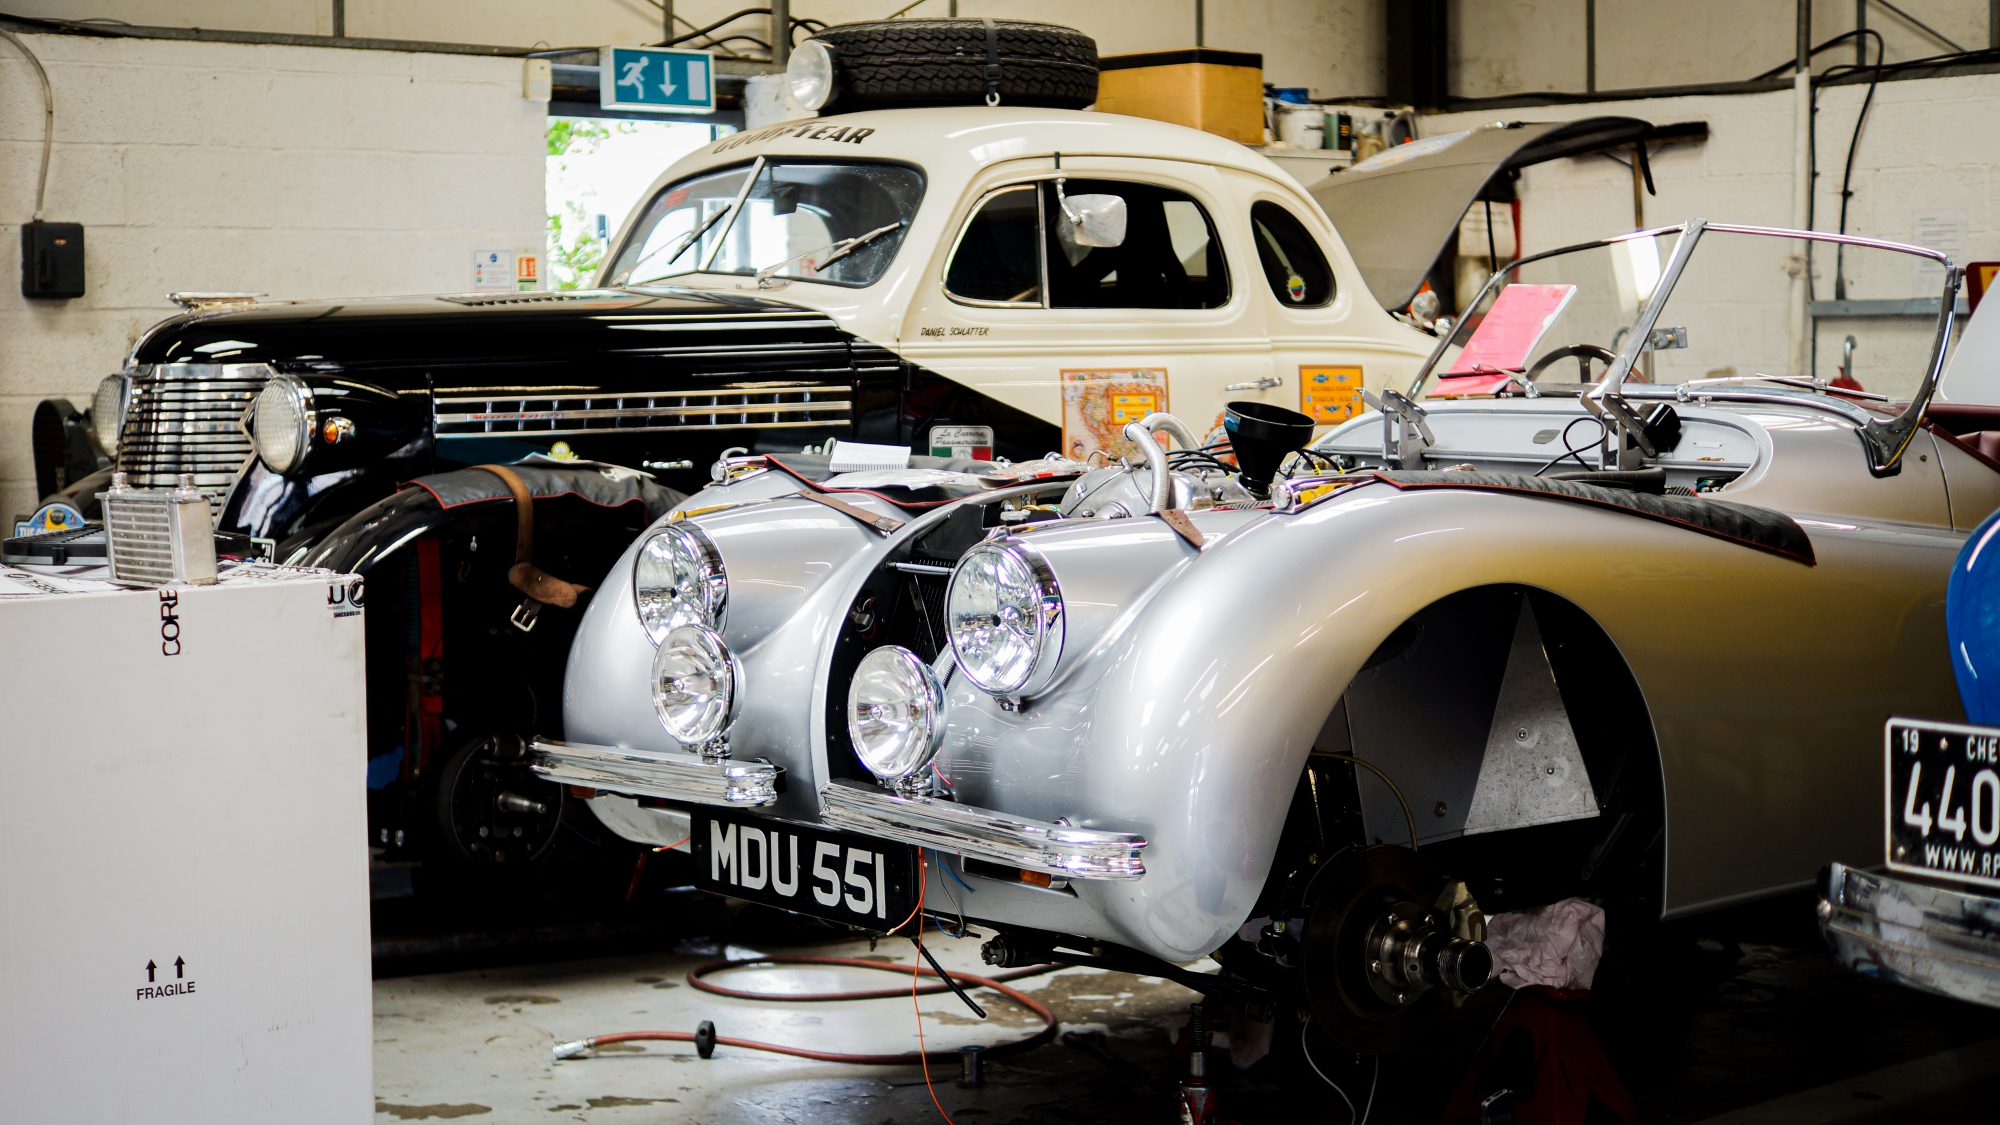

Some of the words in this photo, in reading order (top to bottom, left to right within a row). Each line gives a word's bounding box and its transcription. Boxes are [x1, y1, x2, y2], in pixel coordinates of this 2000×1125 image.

[712, 120, 876, 155] GOODYEAR
[920, 326, 945, 337] DANIEL
[949, 326, 989, 337] SCHLATTER
[939, 428, 951, 437] La
[159, 589, 181, 656] CORE
[1902, 728, 1920, 754] 19
[1903, 760, 2000, 846] 440
[710, 819, 799, 898] MDU
[812, 840, 887, 920] 551
[136, 981, 196, 1001] FRAGILE
